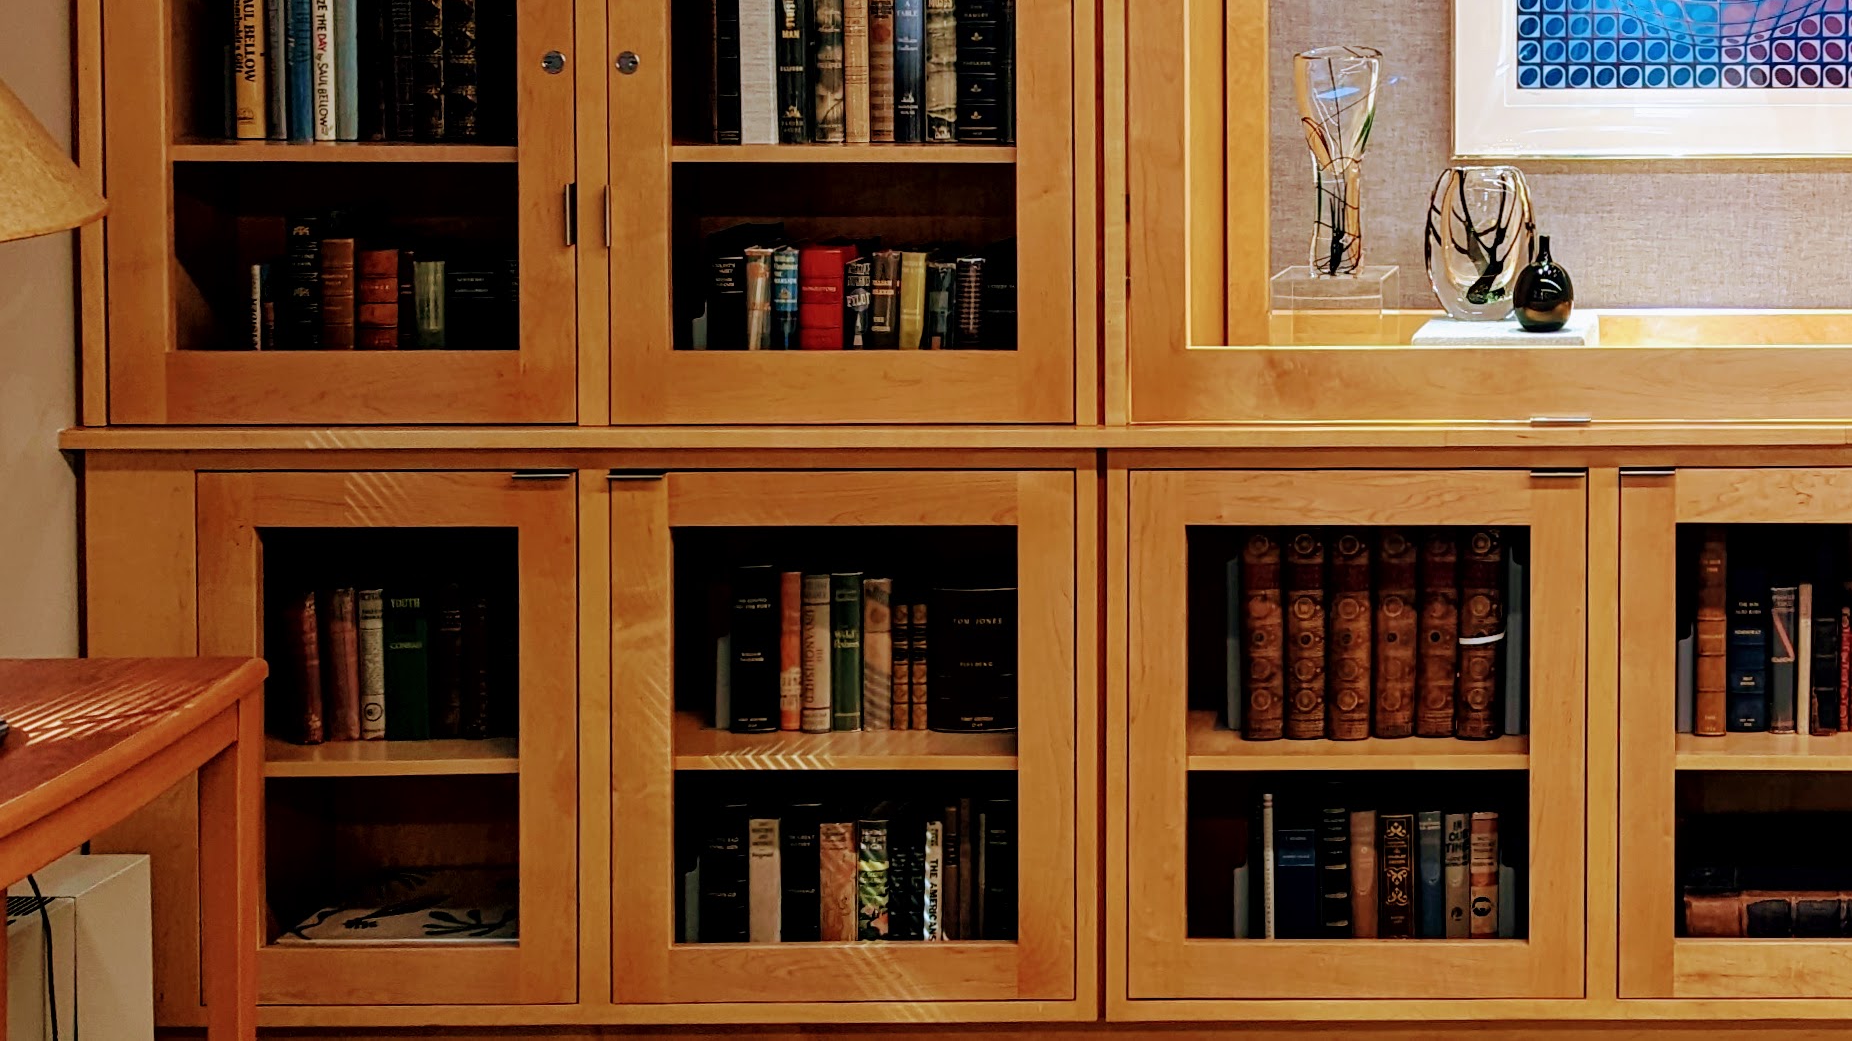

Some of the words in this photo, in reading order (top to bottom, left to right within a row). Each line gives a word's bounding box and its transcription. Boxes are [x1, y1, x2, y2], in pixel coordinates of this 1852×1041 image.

[315, 14, 328, 32] THE
[316, 33, 329, 53] DAY
[781, 29, 800, 39] MAN
[243, 24, 256, 83] BELLOW
[316, 62, 329, 87] SAUL
[316, 89, 329, 127] BELLOW
[390, 597, 421, 608] YOUTH
[952, 617, 970, 625] TOM
[975, 617, 1003, 625] JONES
[804, 610, 815, 704] UNVANQUISHED
[929, 858, 939, 879] THE
[928, 882, 939, 942] AMERICANS
